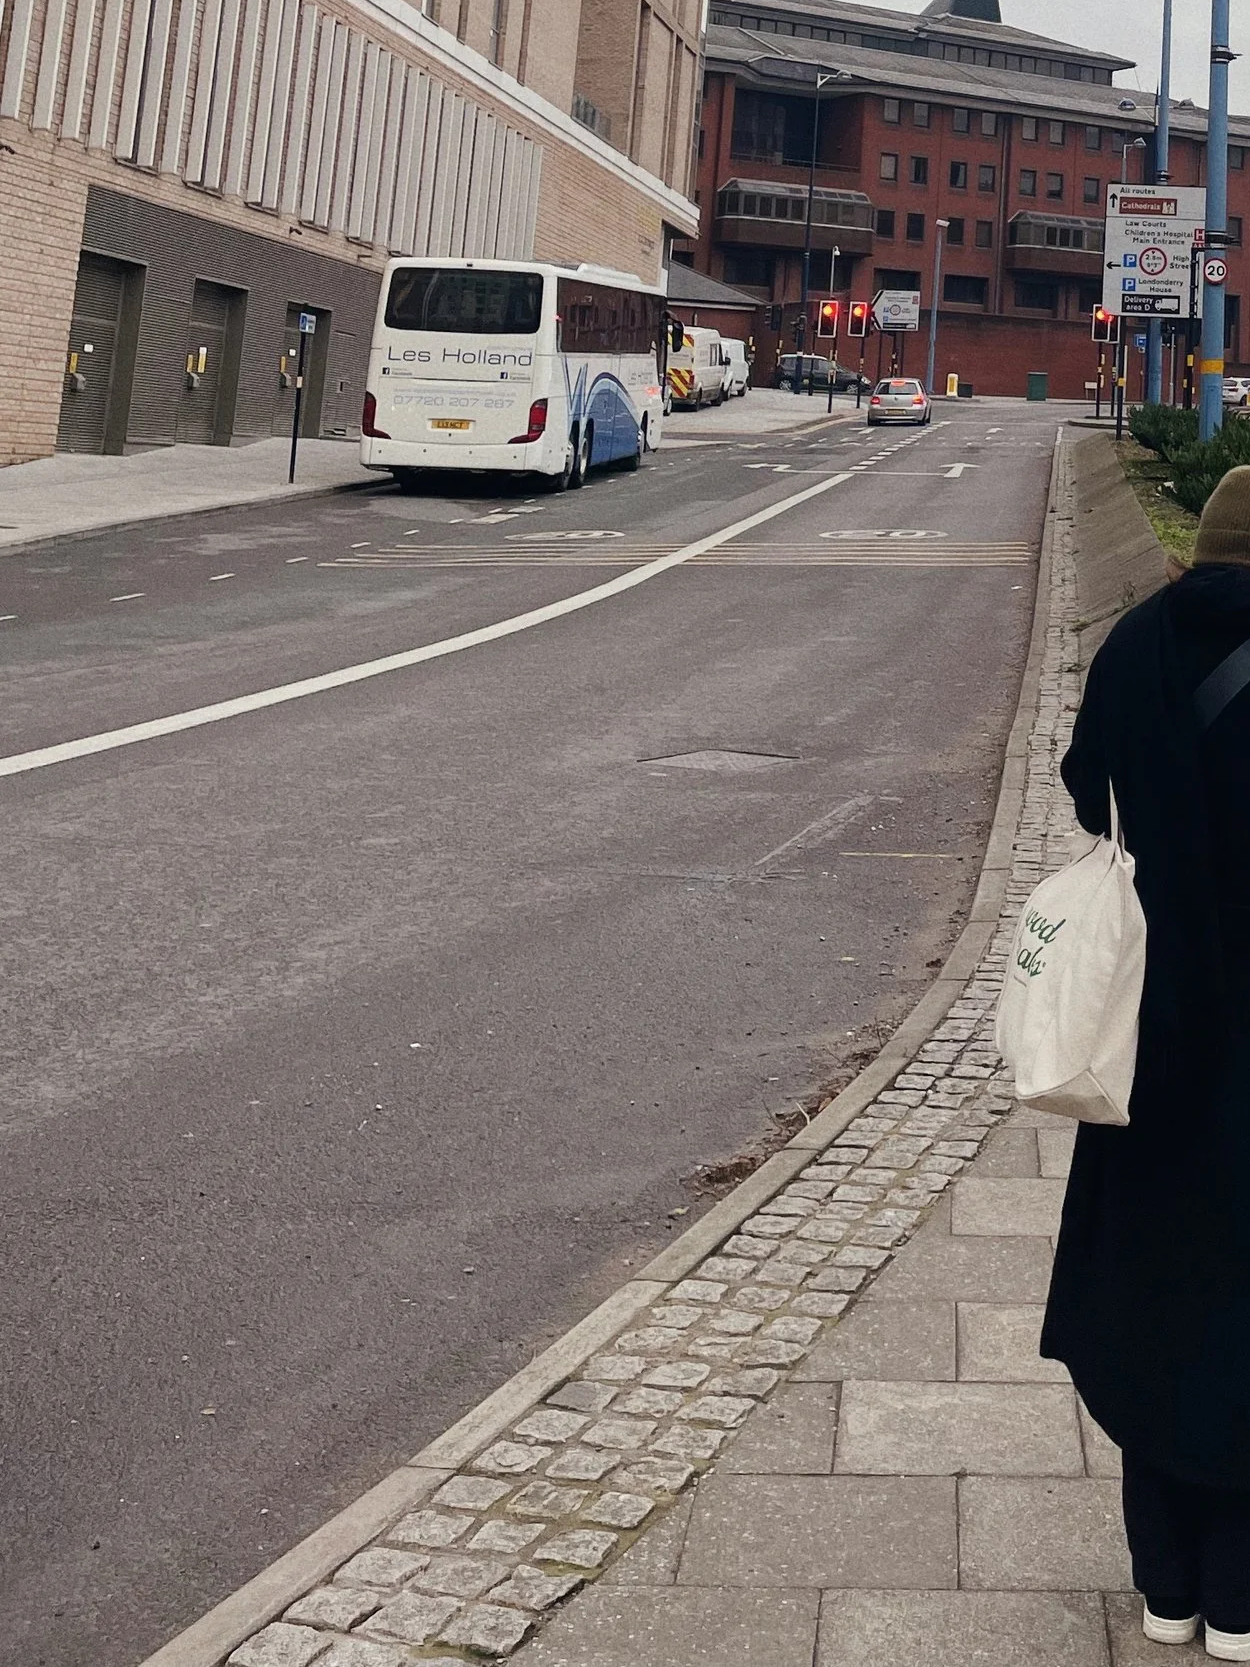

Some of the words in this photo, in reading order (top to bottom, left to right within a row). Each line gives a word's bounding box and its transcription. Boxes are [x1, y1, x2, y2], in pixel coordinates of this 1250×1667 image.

[1120, 187, 1130, 195] All
[1132, 187, 1155, 195] routes
[1121, 202, 1160, 210] Cathedrals
[1142, 220, 1166, 228] Courts
[1163, 230, 1193, 238] Hospital
[1173, 255, 1189, 263] High
[1170, 262, 1190, 270] Stree
[1207, 265, 1225, 277] 20
[1138, 279, 1183, 287] Londonderry
[1124, 296, 1154, 304] Delivery
[387, 345, 431, 362] Les
[442, 347, 532, 366] Holland
[393, 395, 444, 407] 07720
[449, 397, 480, 407] 207
